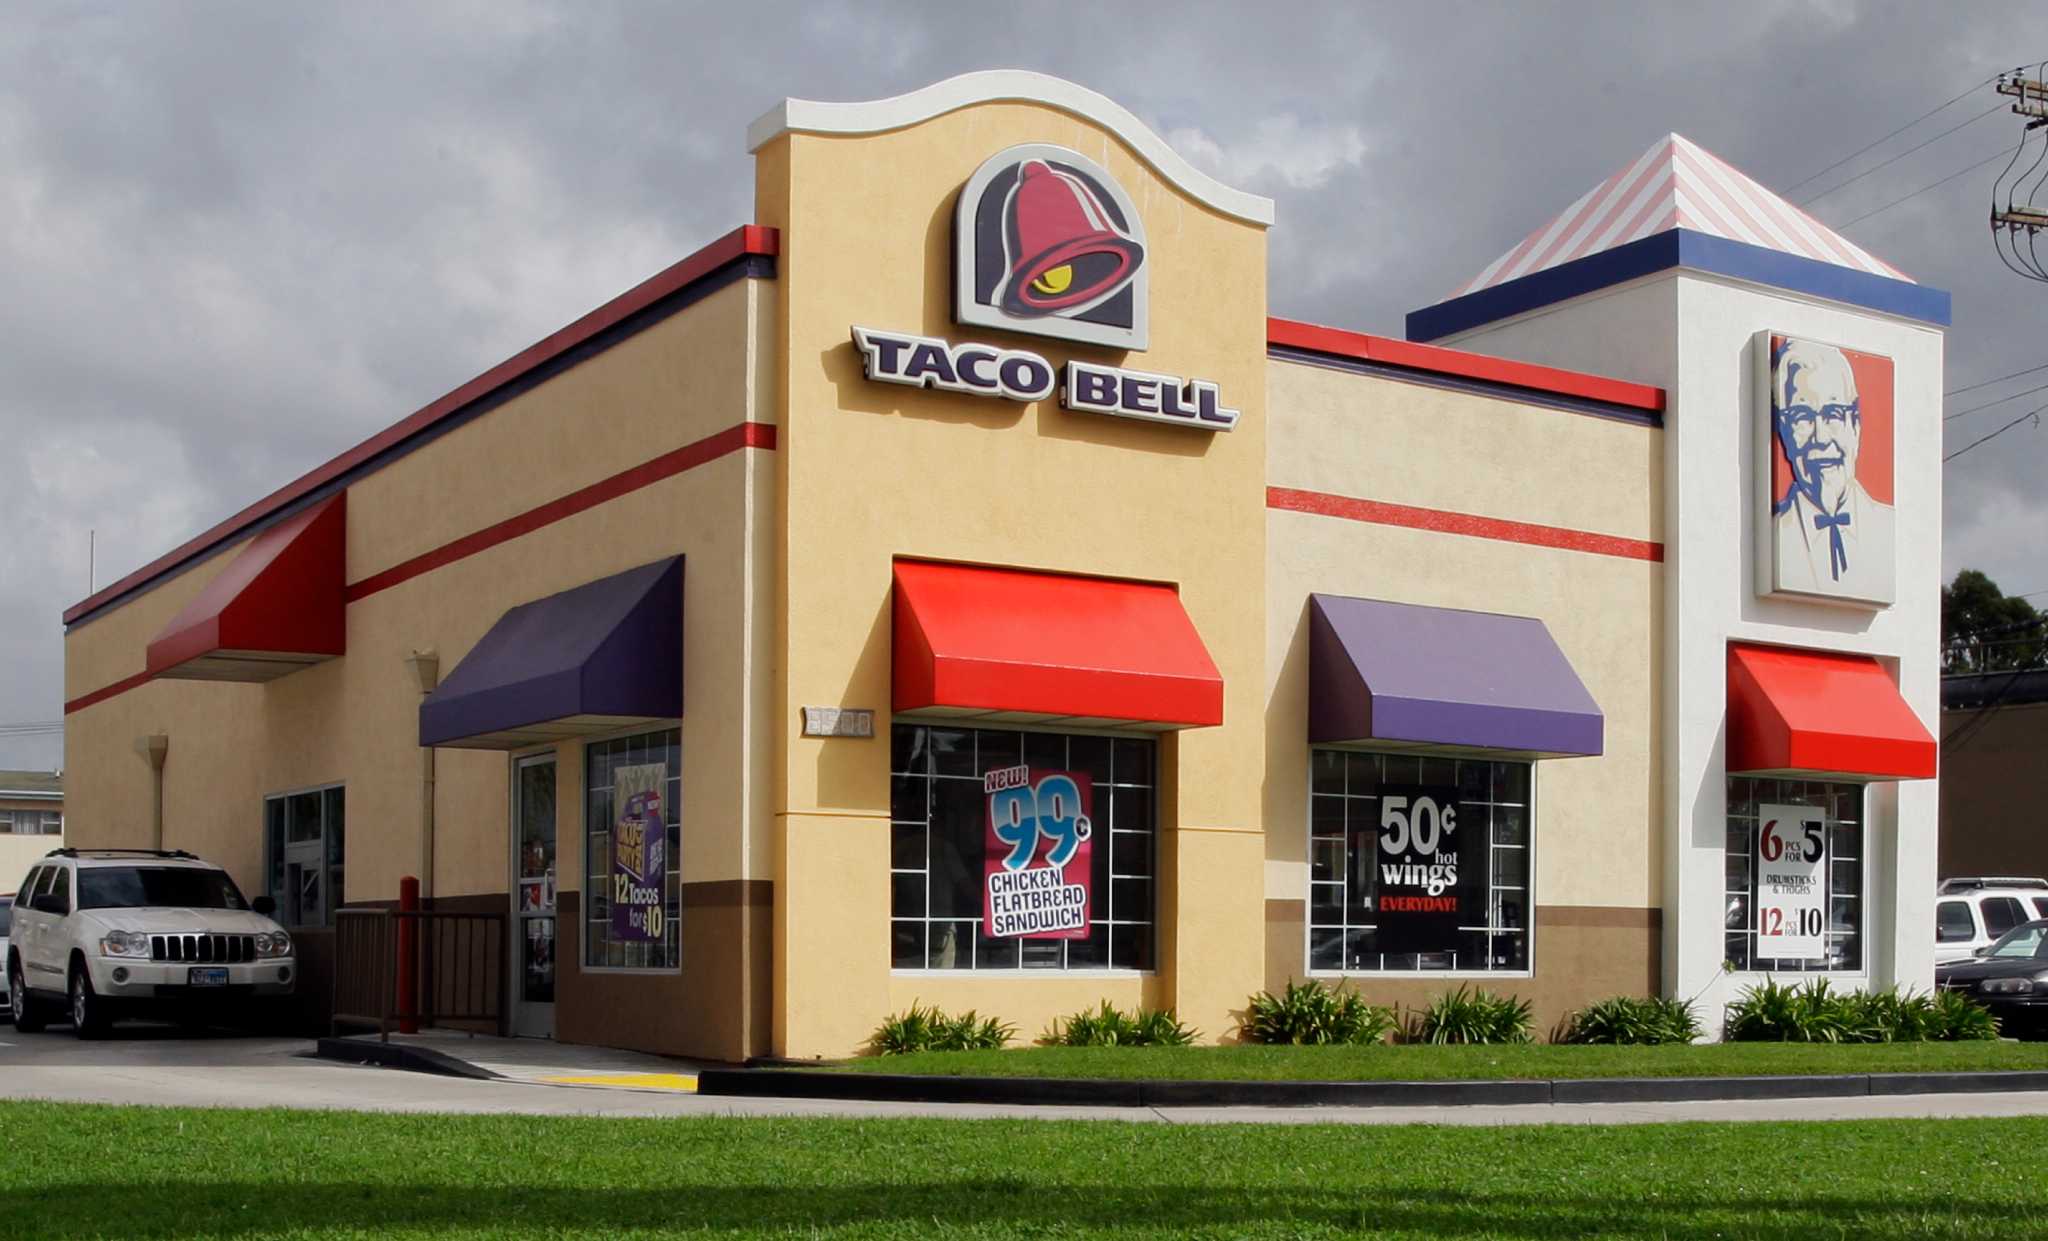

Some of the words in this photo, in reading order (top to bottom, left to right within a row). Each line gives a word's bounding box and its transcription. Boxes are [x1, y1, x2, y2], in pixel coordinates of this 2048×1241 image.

[867, 336, 1050, 394] TACO
[1076, 369, 1233, 424] BELL
[986, 766, 1028, 791] NEW!
[1380, 796, 1456, 855] 50¢
[1761, 820, 1783, 862] 6
[1785, 841, 1800, 851] PCS
[1801, 820, 1824, 863] $5
[1435, 848, 1457, 865] hot
[1785, 852, 1801, 863] FOR
[615, 873, 629, 904] 12
[629, 882, 659, 905] Tacos
[991, 869, 1062, 894] CHICKEN
[1381, 855, 1457, 896] wings
[1766, 874, 1817, 885] DRUMSTICKS
[993, 886, 1084, 914] FLATBREAD
[1782, 885, 1811, 895] THIGHS
[1380, 897, 1457, 912] EVERYDAY!
[629, 906, 642, 928] for
[643, 906, 662, 938] $10
[994, 907, 1082, 934] SANDWICH
[1760, 908, 1783, 937] 12
